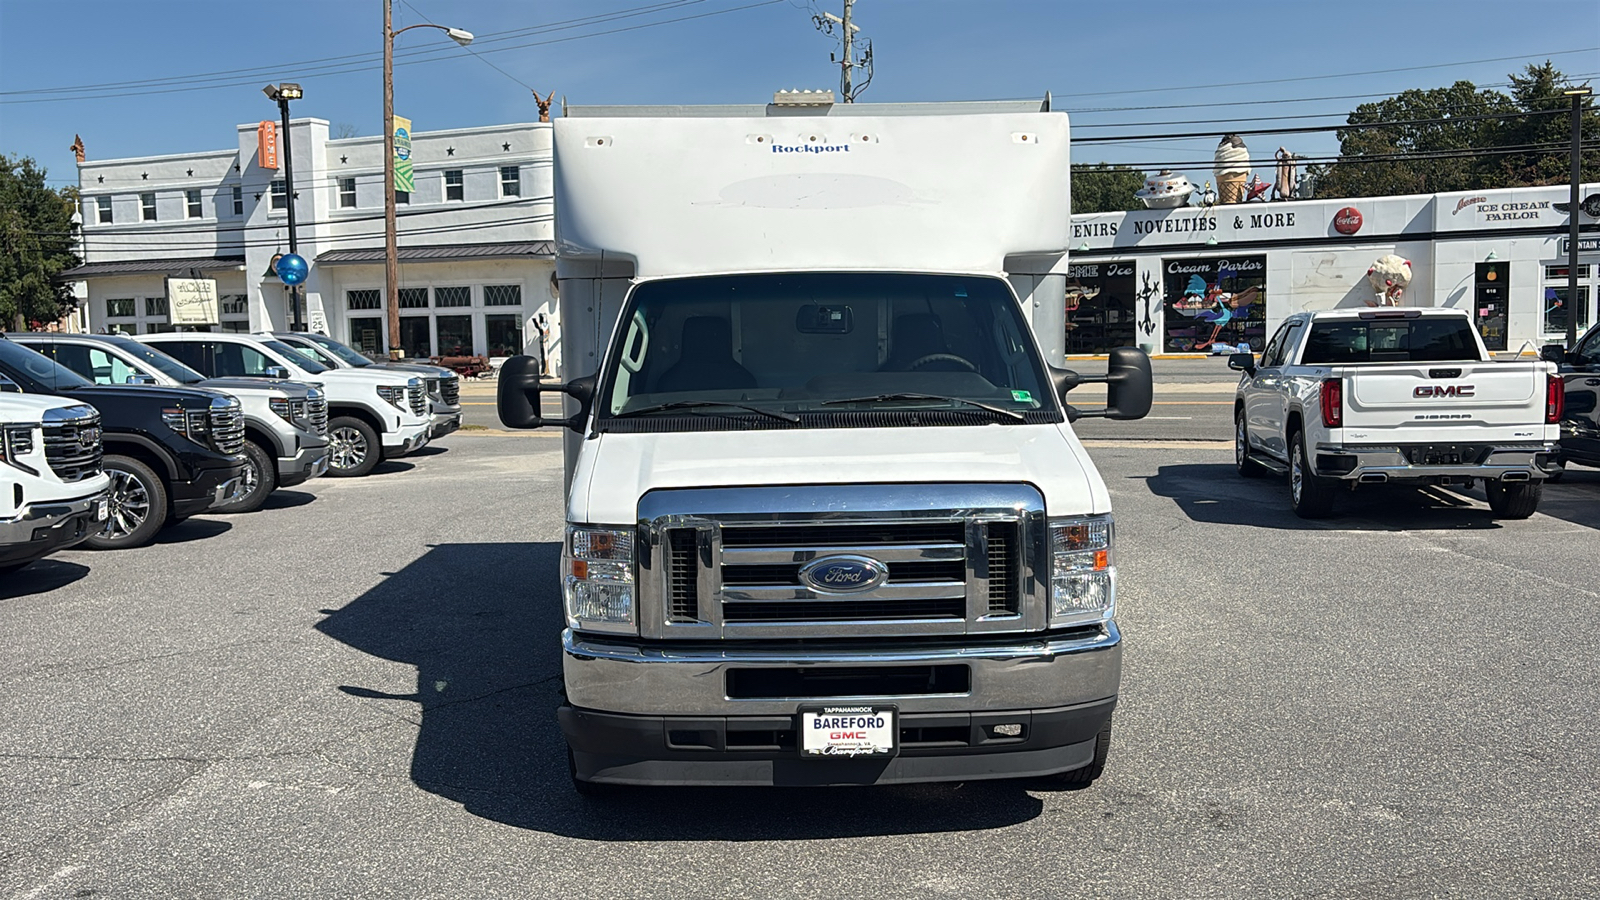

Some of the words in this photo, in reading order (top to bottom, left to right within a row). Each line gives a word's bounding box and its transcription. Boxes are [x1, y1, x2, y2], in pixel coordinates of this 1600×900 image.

[267, 124, 275, 166] ACME
[772, 144, 850, 154] Rockport
[1477, 204, 1498, 213] ICE
[1501, 201, 1550, 211] CREAM
[1486, 211, 1540, 221] PARLOR
[1134, 216, 1217, 235] NOVELTIES
[1233, 215, 1244, 230] &
[1250, 212, 1295, 228] MORE
[1565, 241, 1597, 250] FNTAIN
[1107, 263, 1134, 277] Ice
[1168, 261, 1211, 274] Cream
[1217, 259, 1263, 272] Parlor
[312, 320, 324, 330] 25
[1415, 385, 1475, 397] GMC
[824, 566, 863, 583] Ford
[813, 717, 885, 730] BAREFORD
[830, 731, 867, 740] GMC
